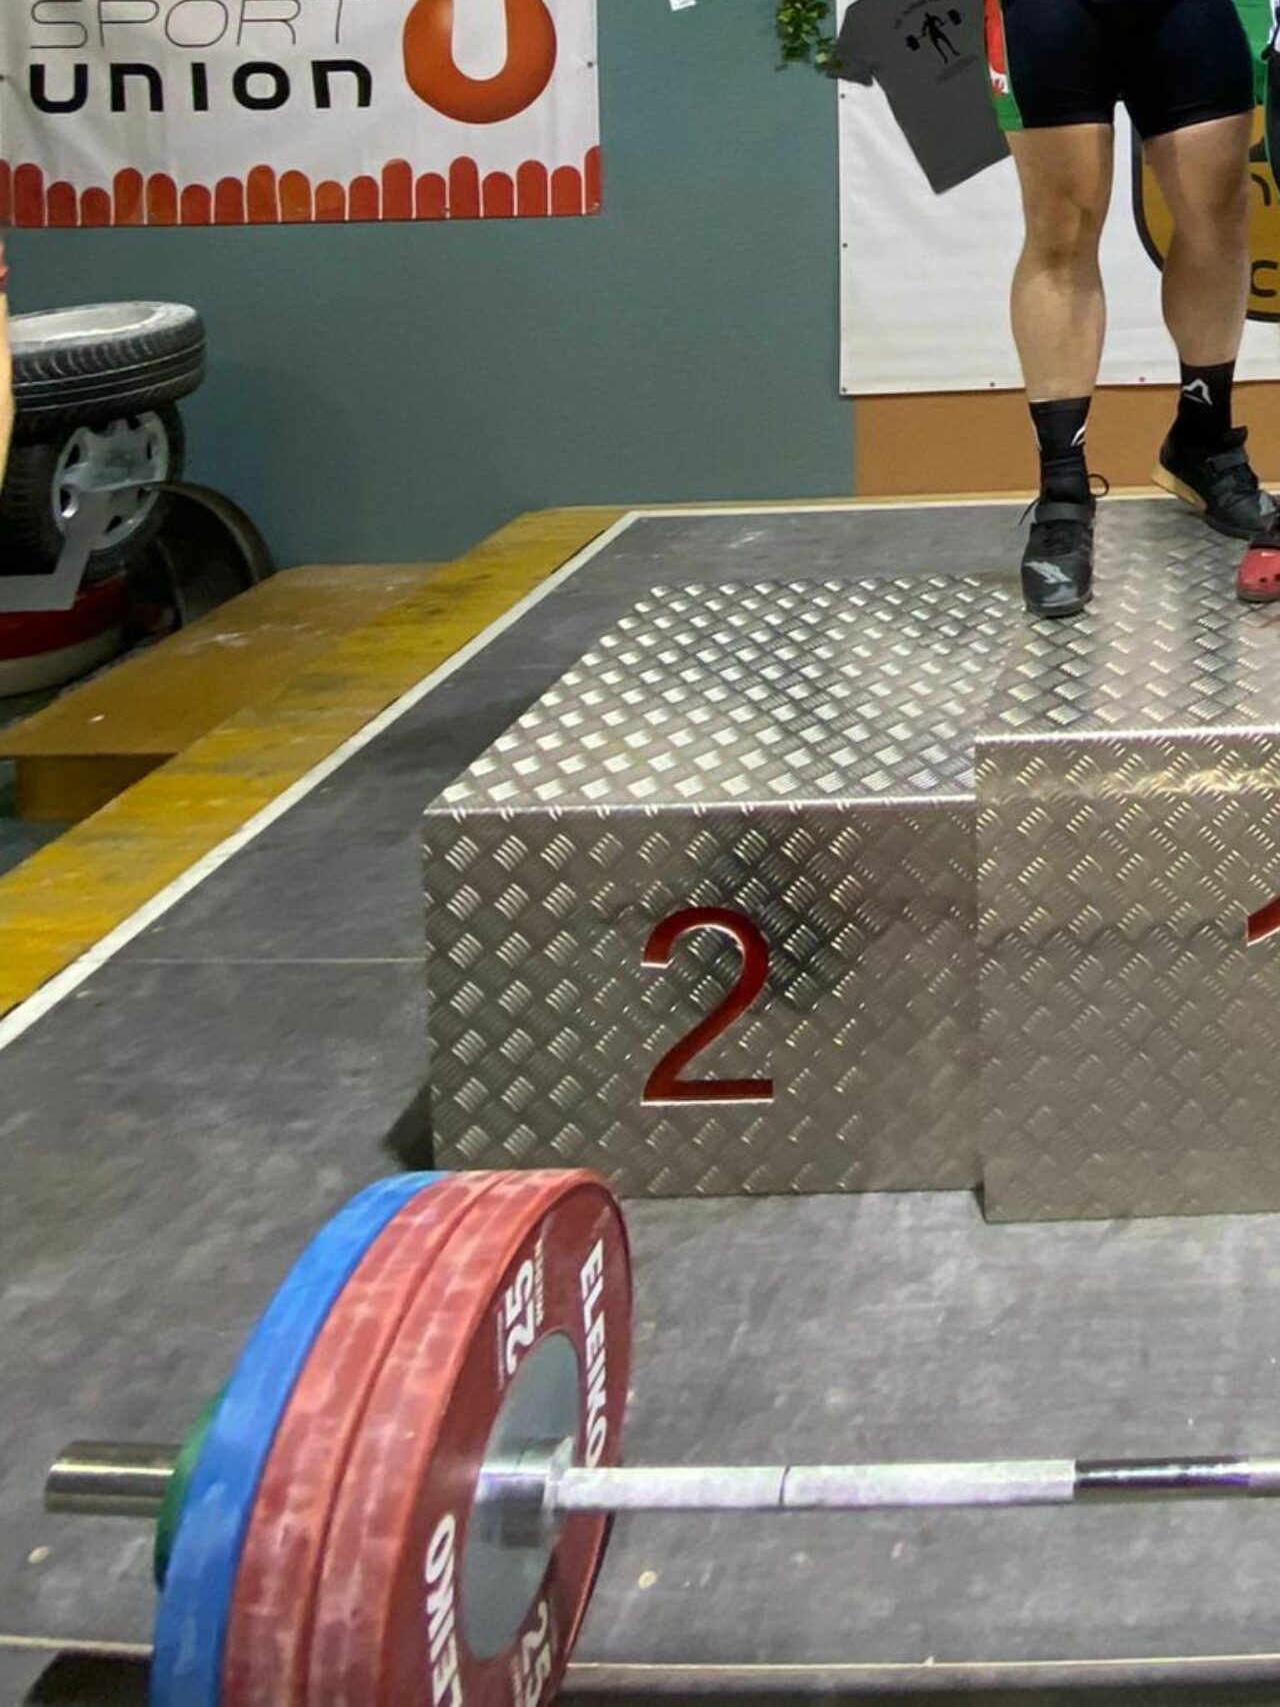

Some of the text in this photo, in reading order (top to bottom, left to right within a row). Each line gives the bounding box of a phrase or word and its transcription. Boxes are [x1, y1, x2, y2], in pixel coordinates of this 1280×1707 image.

[29, 59, 373, 114] union
[641, 905, 775, 1107] 2
[505, 1259, 535, 1376] 25
[580, 1239, 608, 1469] ELEIKO
